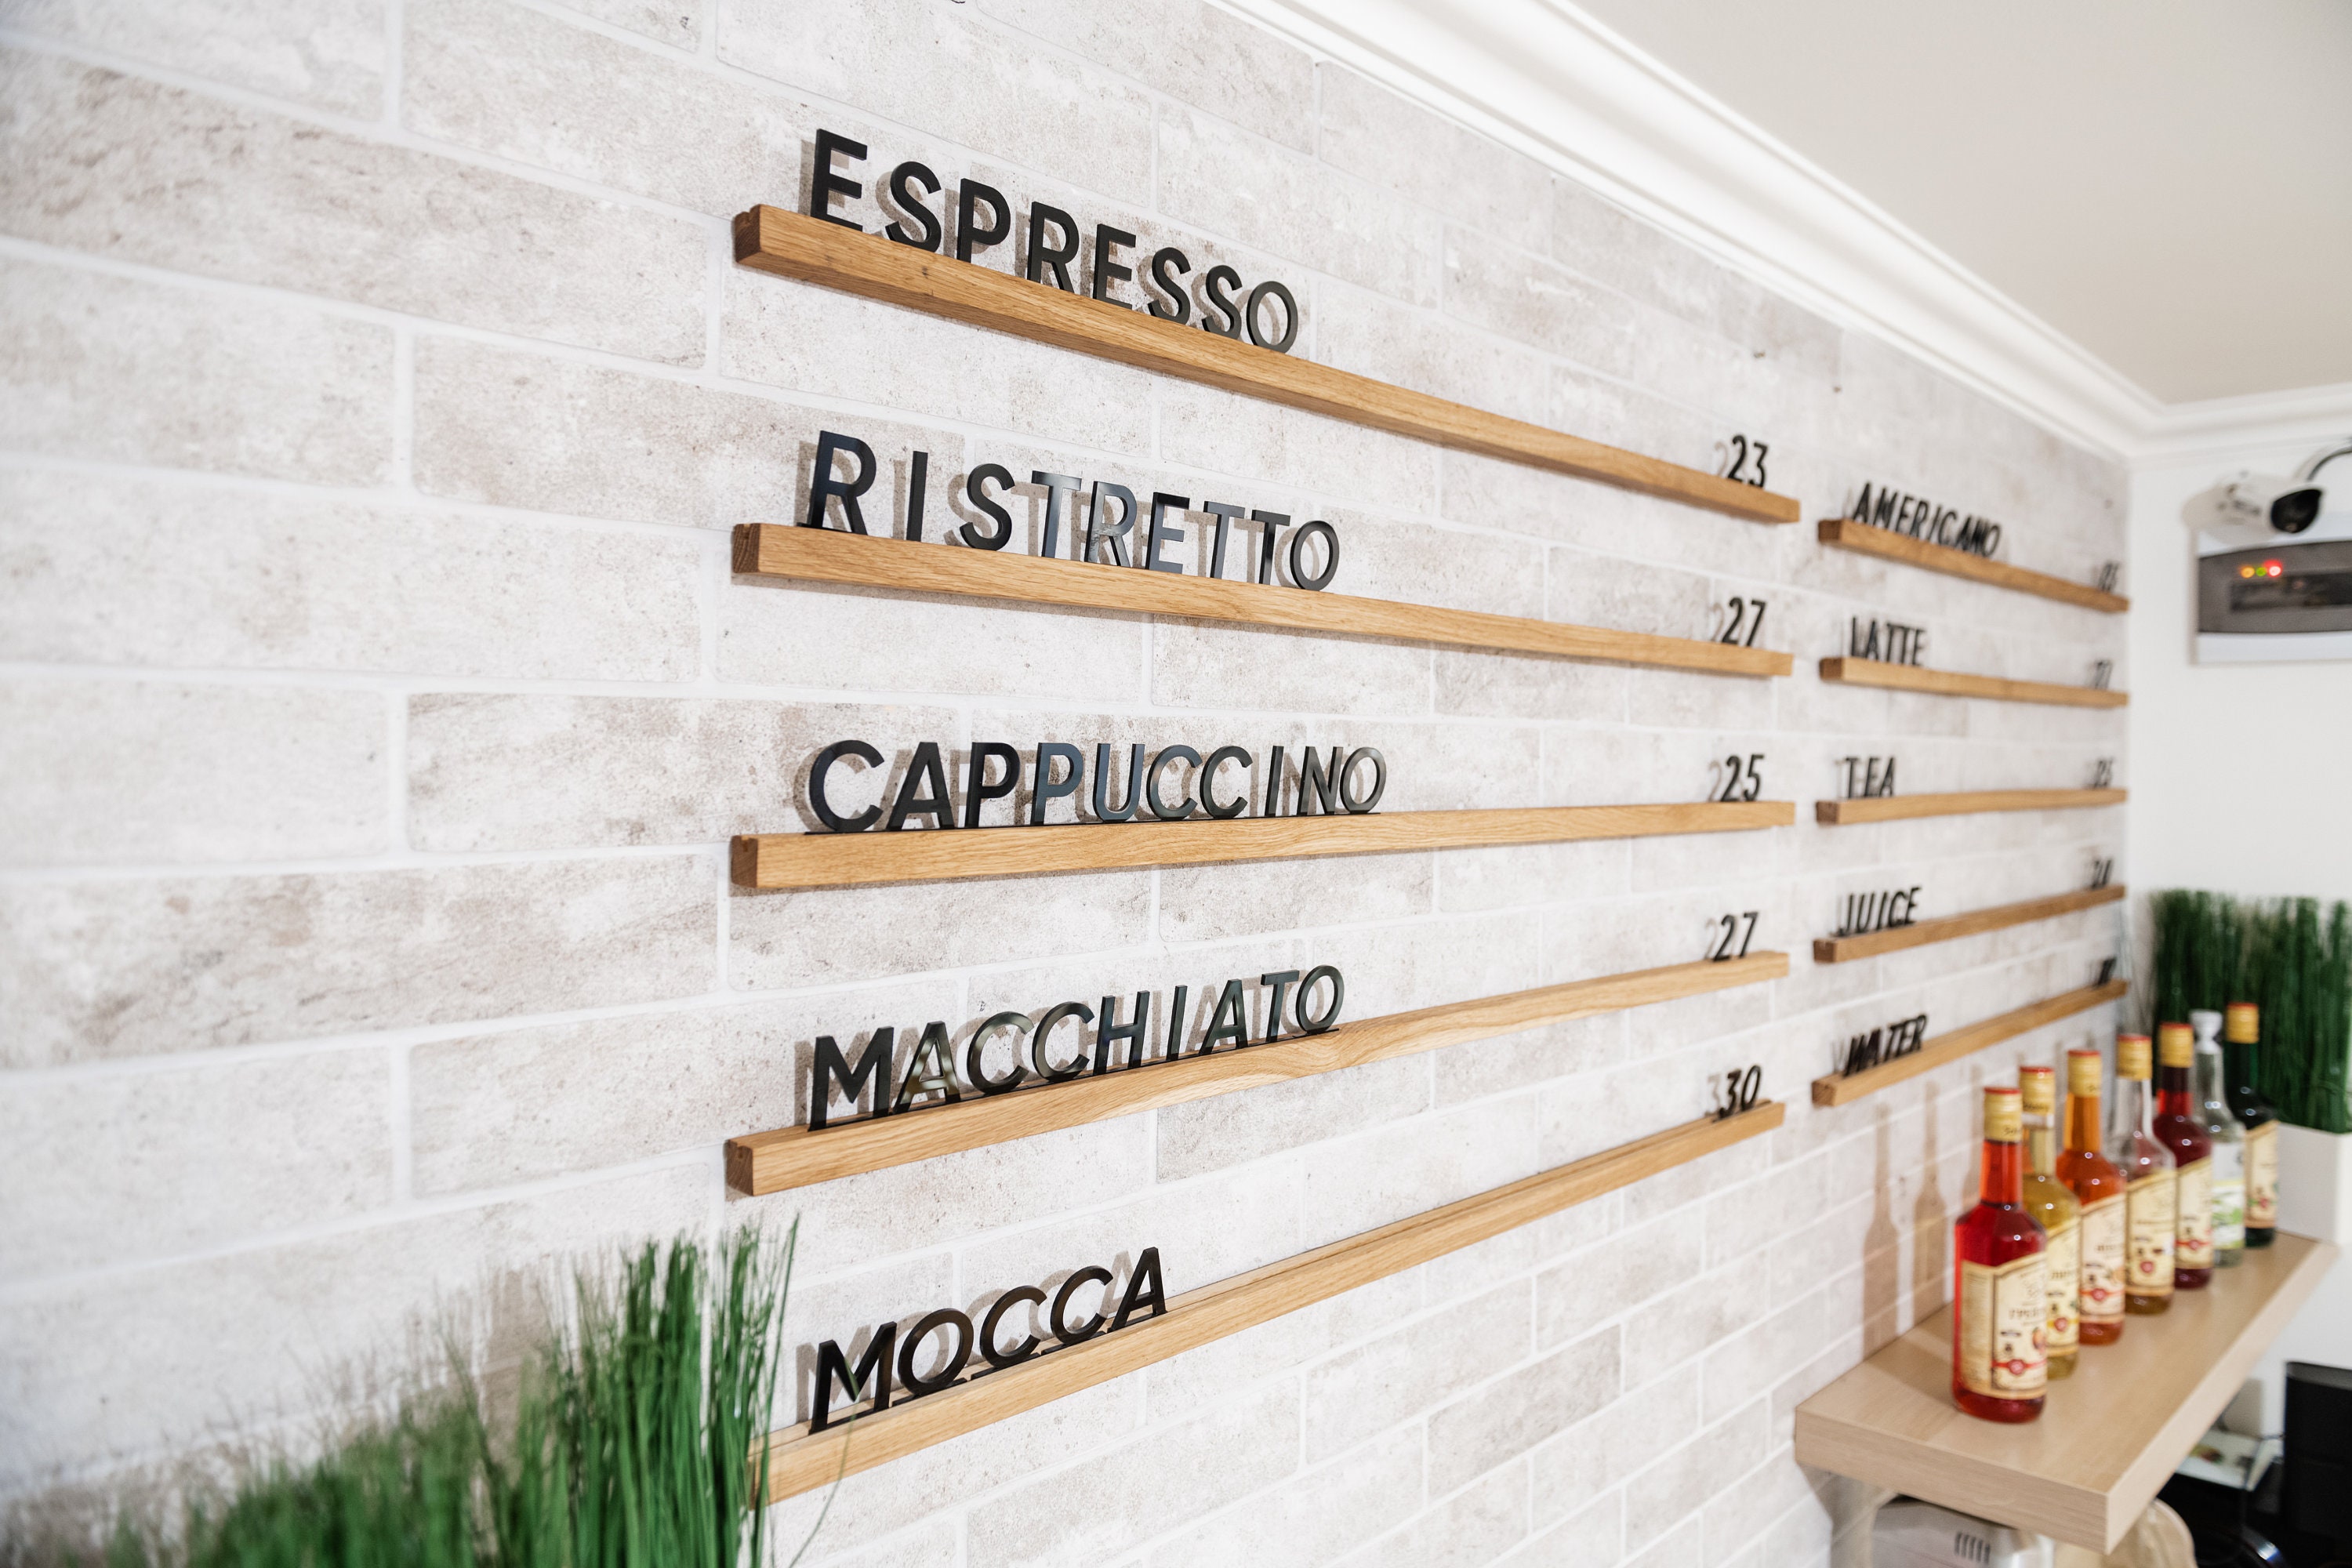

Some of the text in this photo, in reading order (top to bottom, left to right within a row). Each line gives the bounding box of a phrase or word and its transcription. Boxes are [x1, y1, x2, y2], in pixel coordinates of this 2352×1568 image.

[811, 129, 1299, 354] ESPRESSO
[1727, 435, 1768, 488] 23
[808, 430, 1339, 591] RISTRETTO
[1852, 481, 2002, 558] AMERICANO
[1721, 597, 1766, 647] 27
[1850, 616, 1926, 666] LATTE
[809, 740, 1387, 833] CAPPUCCINO
[1721, 754, 1764, 801] 25
[1846, 757, 1896, 799] TEA
[1712, 912, 1759, 962] 27
[1838, 887, 1922, 937] JUICE
[808, 964, 1345, 1131] MACCHIATO
[1843, 1014, 1929, 1076] WATER
[1718, 1065, 1762, 1120] 30
[809, 1247, 1168, 1435] MOCCA
